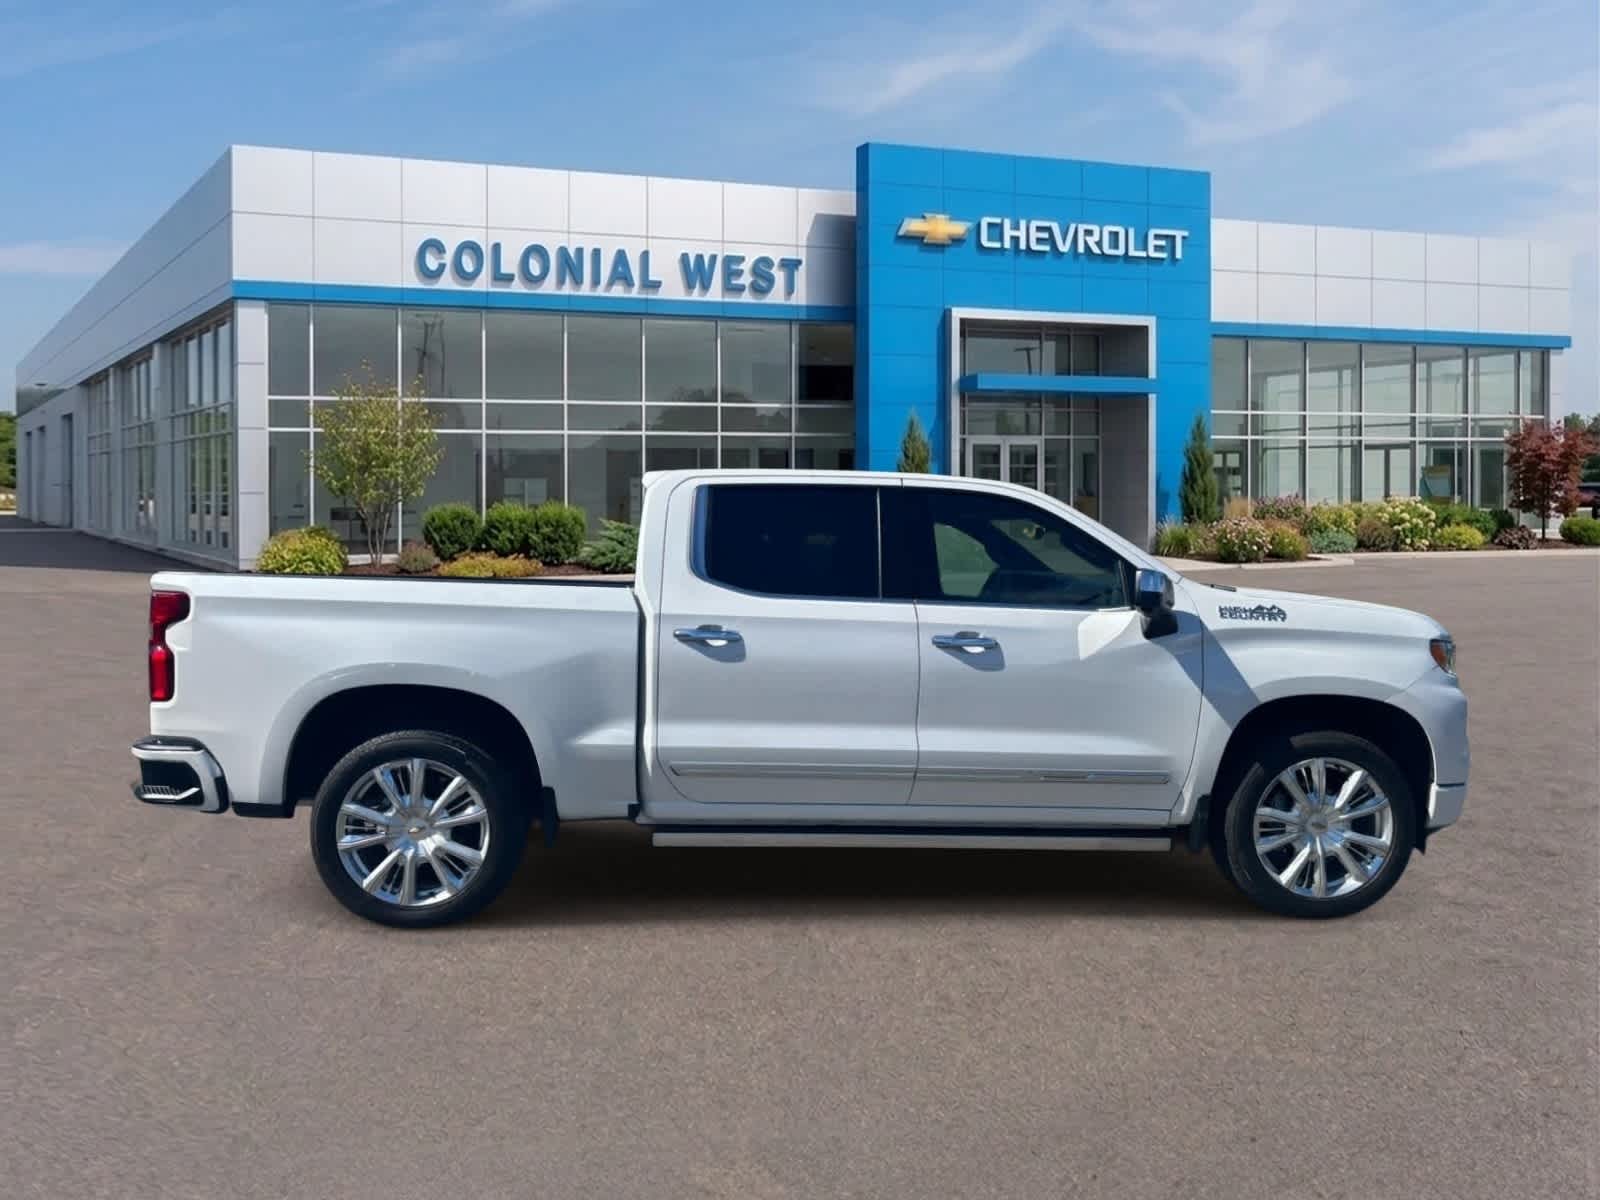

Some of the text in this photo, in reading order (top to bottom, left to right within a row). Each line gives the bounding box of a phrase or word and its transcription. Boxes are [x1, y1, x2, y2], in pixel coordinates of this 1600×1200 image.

[980, 216, 1189, 260] CHEVROLET
[416, 237, 803, 297] COLONIAL WEST
